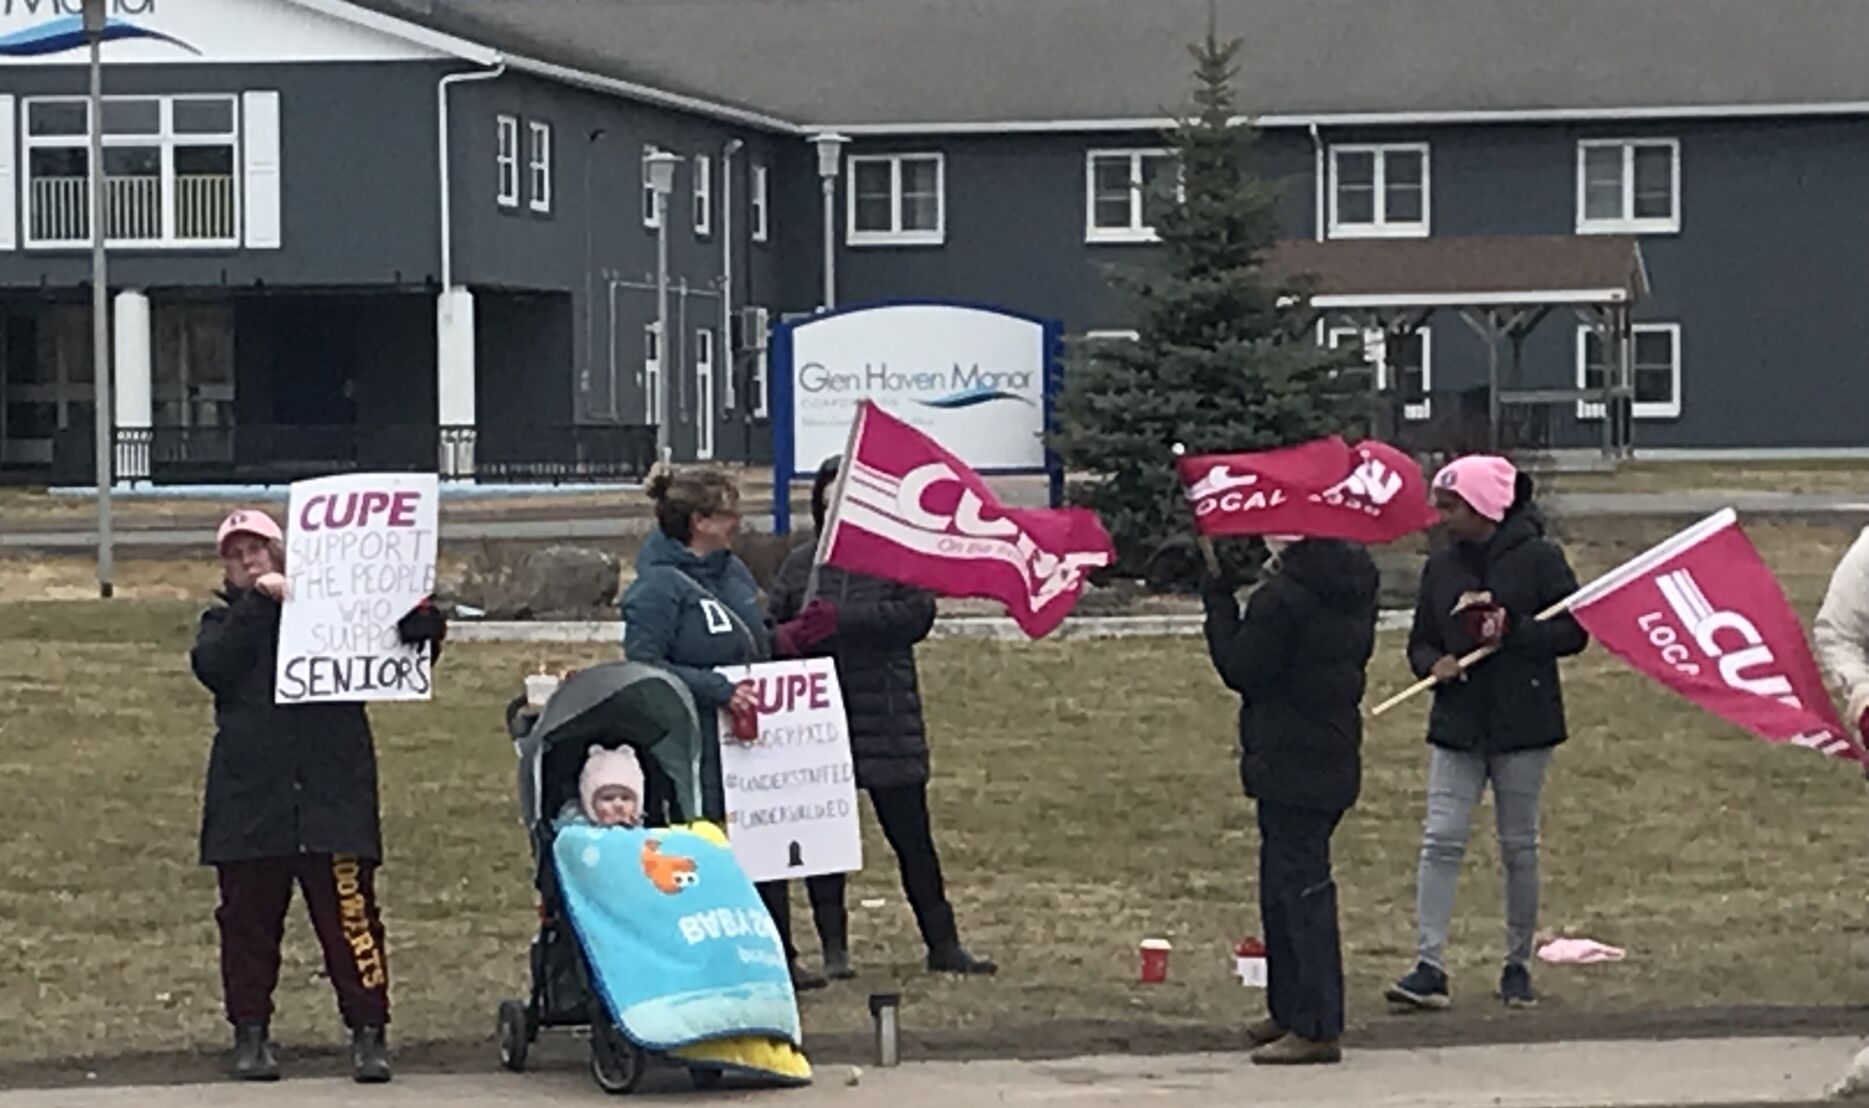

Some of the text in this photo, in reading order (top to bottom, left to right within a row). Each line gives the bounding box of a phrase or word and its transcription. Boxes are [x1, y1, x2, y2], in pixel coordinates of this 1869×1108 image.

[799, 363, 1033, 393] Glen Haven Manor
[300, 491, 421, 531] CUPE
[1194, 489, 1287, 516] OCAL
[291, 530, 432, 569] SUPPORT
[288, 563, 436, 602] THE PEOPLE
[338, 600, 392, 623] WHO
[278, 655, 430, 700] SENIORS
[739, 672, 831, 716] UPE
